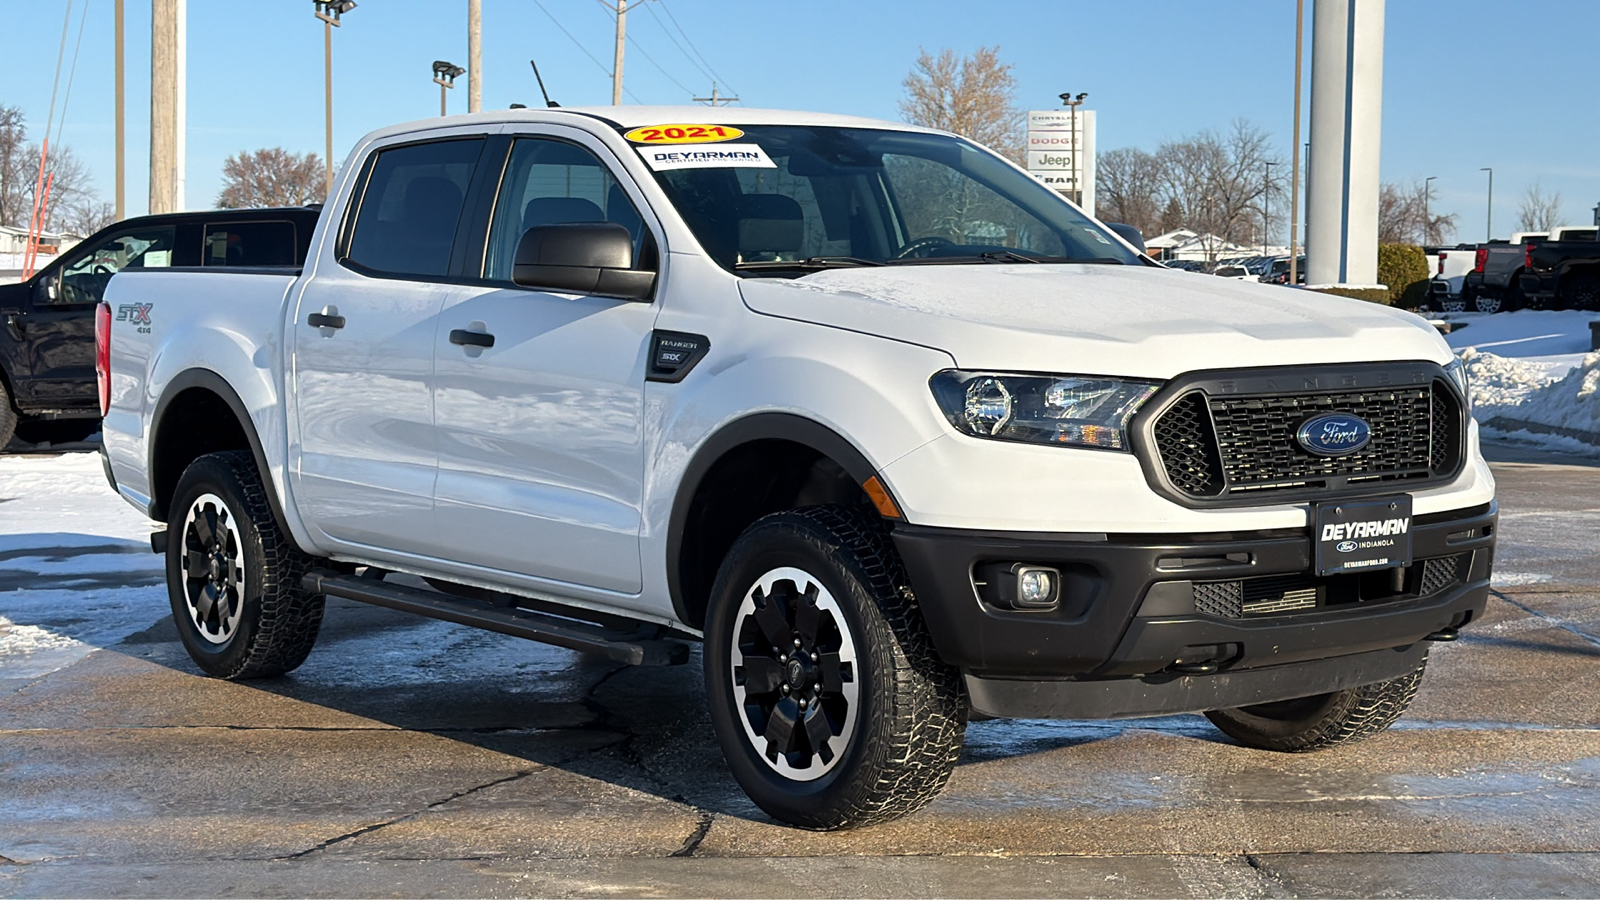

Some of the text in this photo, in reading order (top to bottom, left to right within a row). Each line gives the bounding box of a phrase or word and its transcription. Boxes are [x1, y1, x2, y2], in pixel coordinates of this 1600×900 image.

[641, 127, 727, 141] 2021
[654, 152, 759, 161] DEYARMAN
[1038, 153, 1071, 168] Jeep
[116, 302, 153, 325] STX
[660, 340, 698, 349] RANGER
[661, 353, 680, 361] STX
[1219, 372, 1424, 393] RANGER
[1320, 421, 1358, 445] Ford
[1321, 518, 1409, 541] DEYARMAN
[1359, 539, 1394, 549] INDIANOLA
